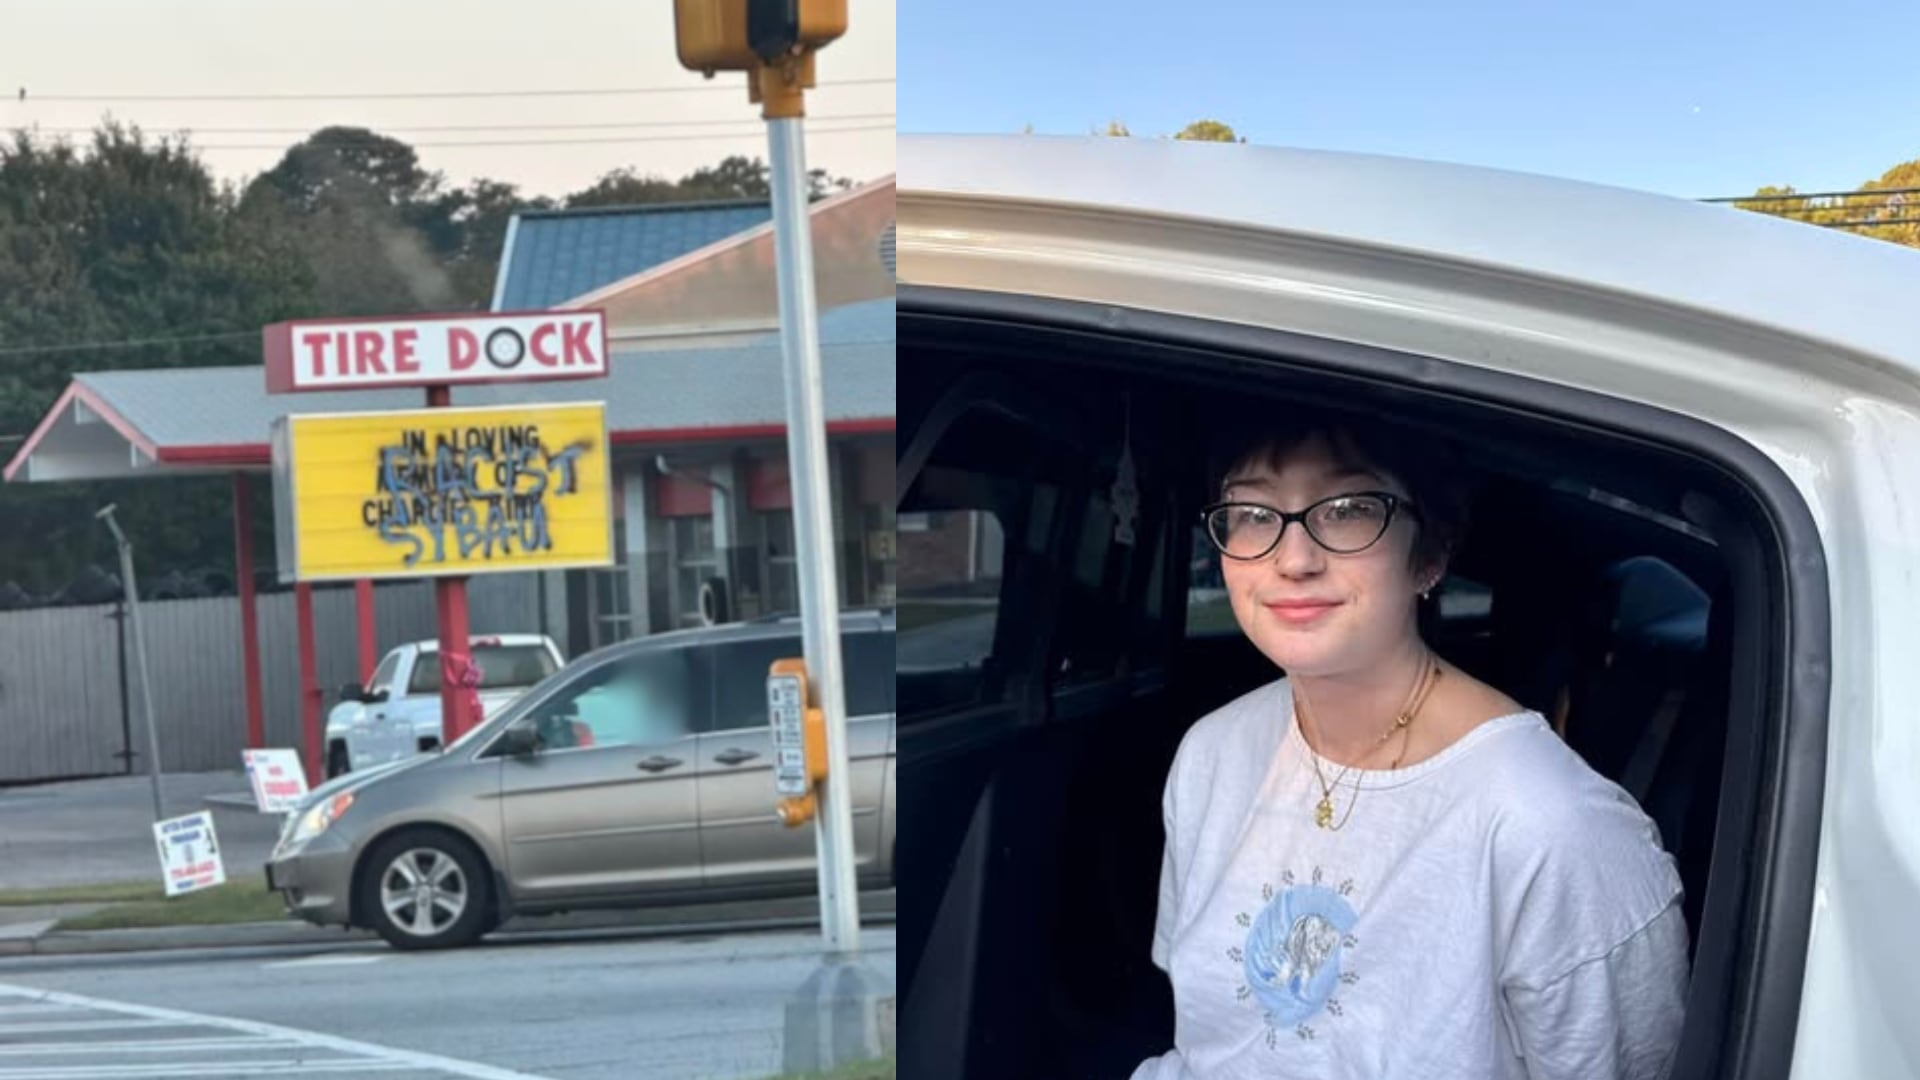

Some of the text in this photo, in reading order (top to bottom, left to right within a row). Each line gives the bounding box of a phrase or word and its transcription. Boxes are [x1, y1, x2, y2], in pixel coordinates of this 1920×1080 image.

[303, 322, 597, 377] TIRE DOCK
[403, 425, 540, 456] IN LOVING
